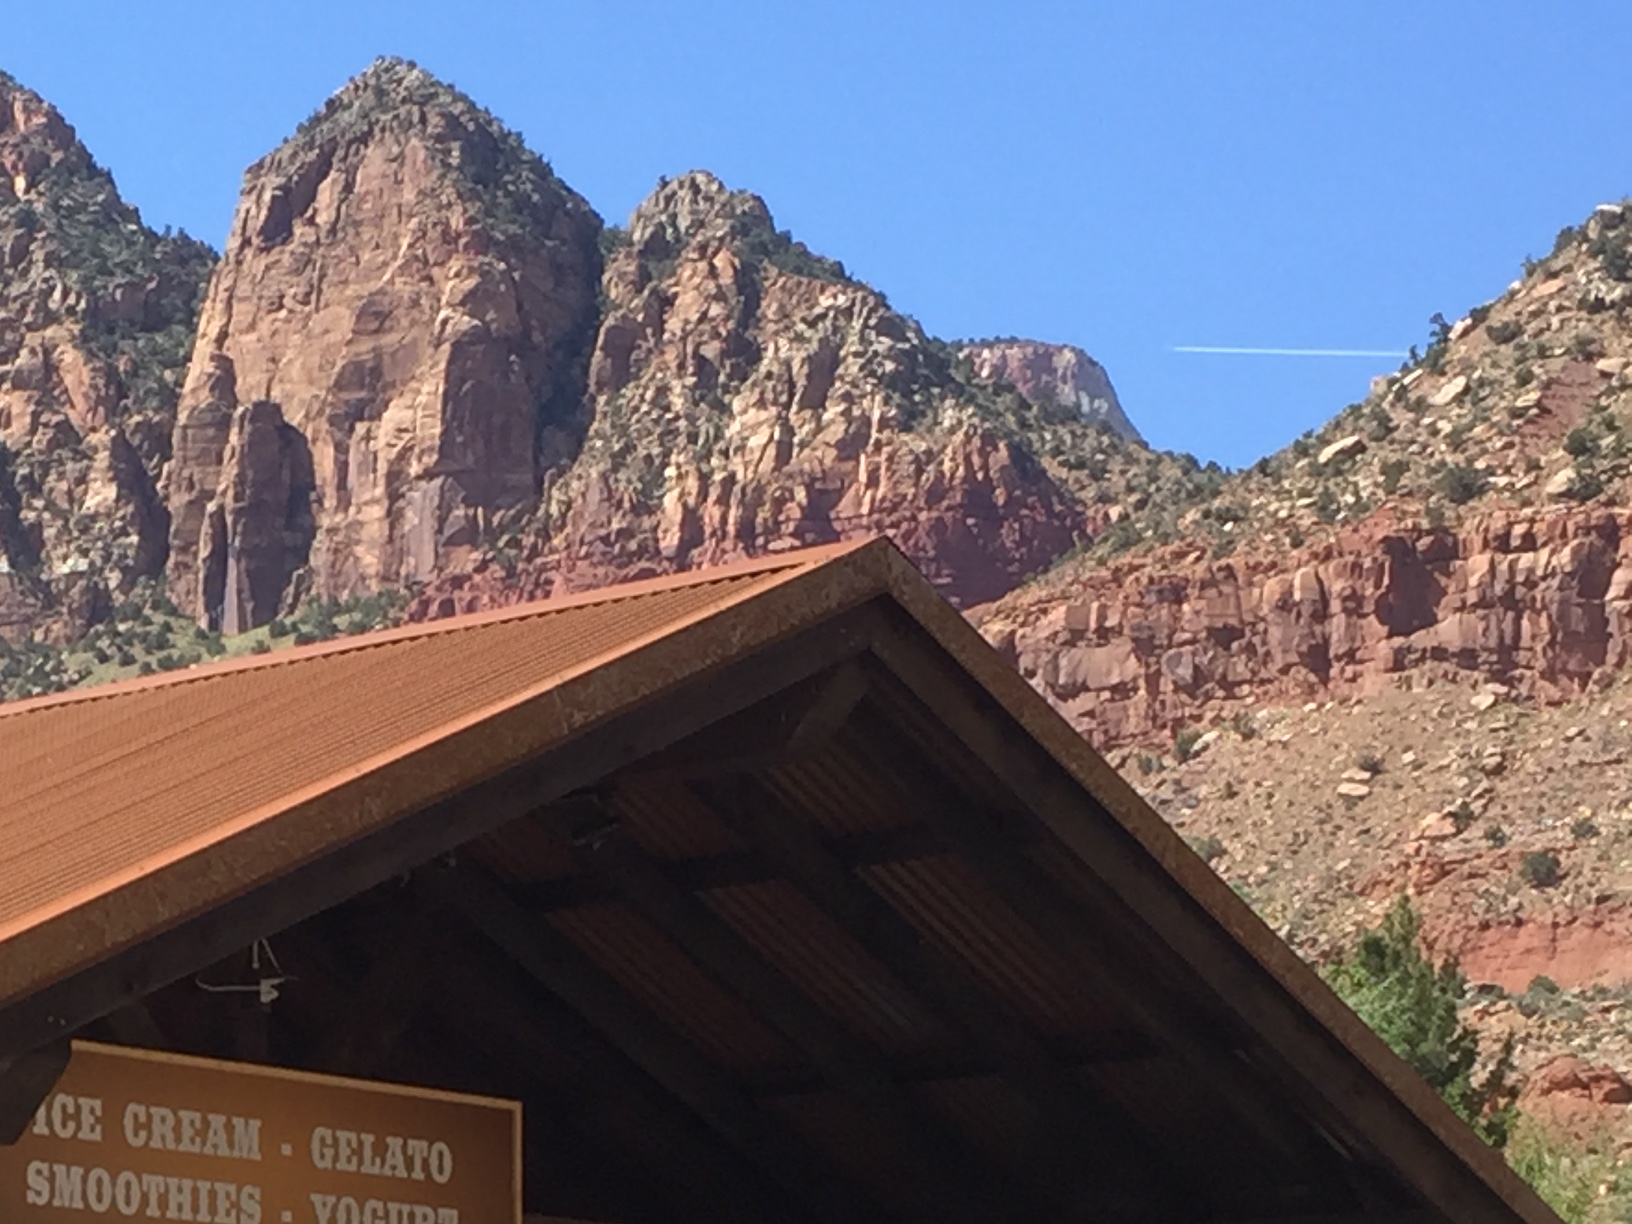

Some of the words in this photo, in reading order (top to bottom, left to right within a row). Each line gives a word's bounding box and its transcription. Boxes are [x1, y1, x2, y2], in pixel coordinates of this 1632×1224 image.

[32, 1093, 102, 1141] ICE
[123, 1102, 262, 1160] CREAM
[311, 1126, 453, 1184] GELATO
